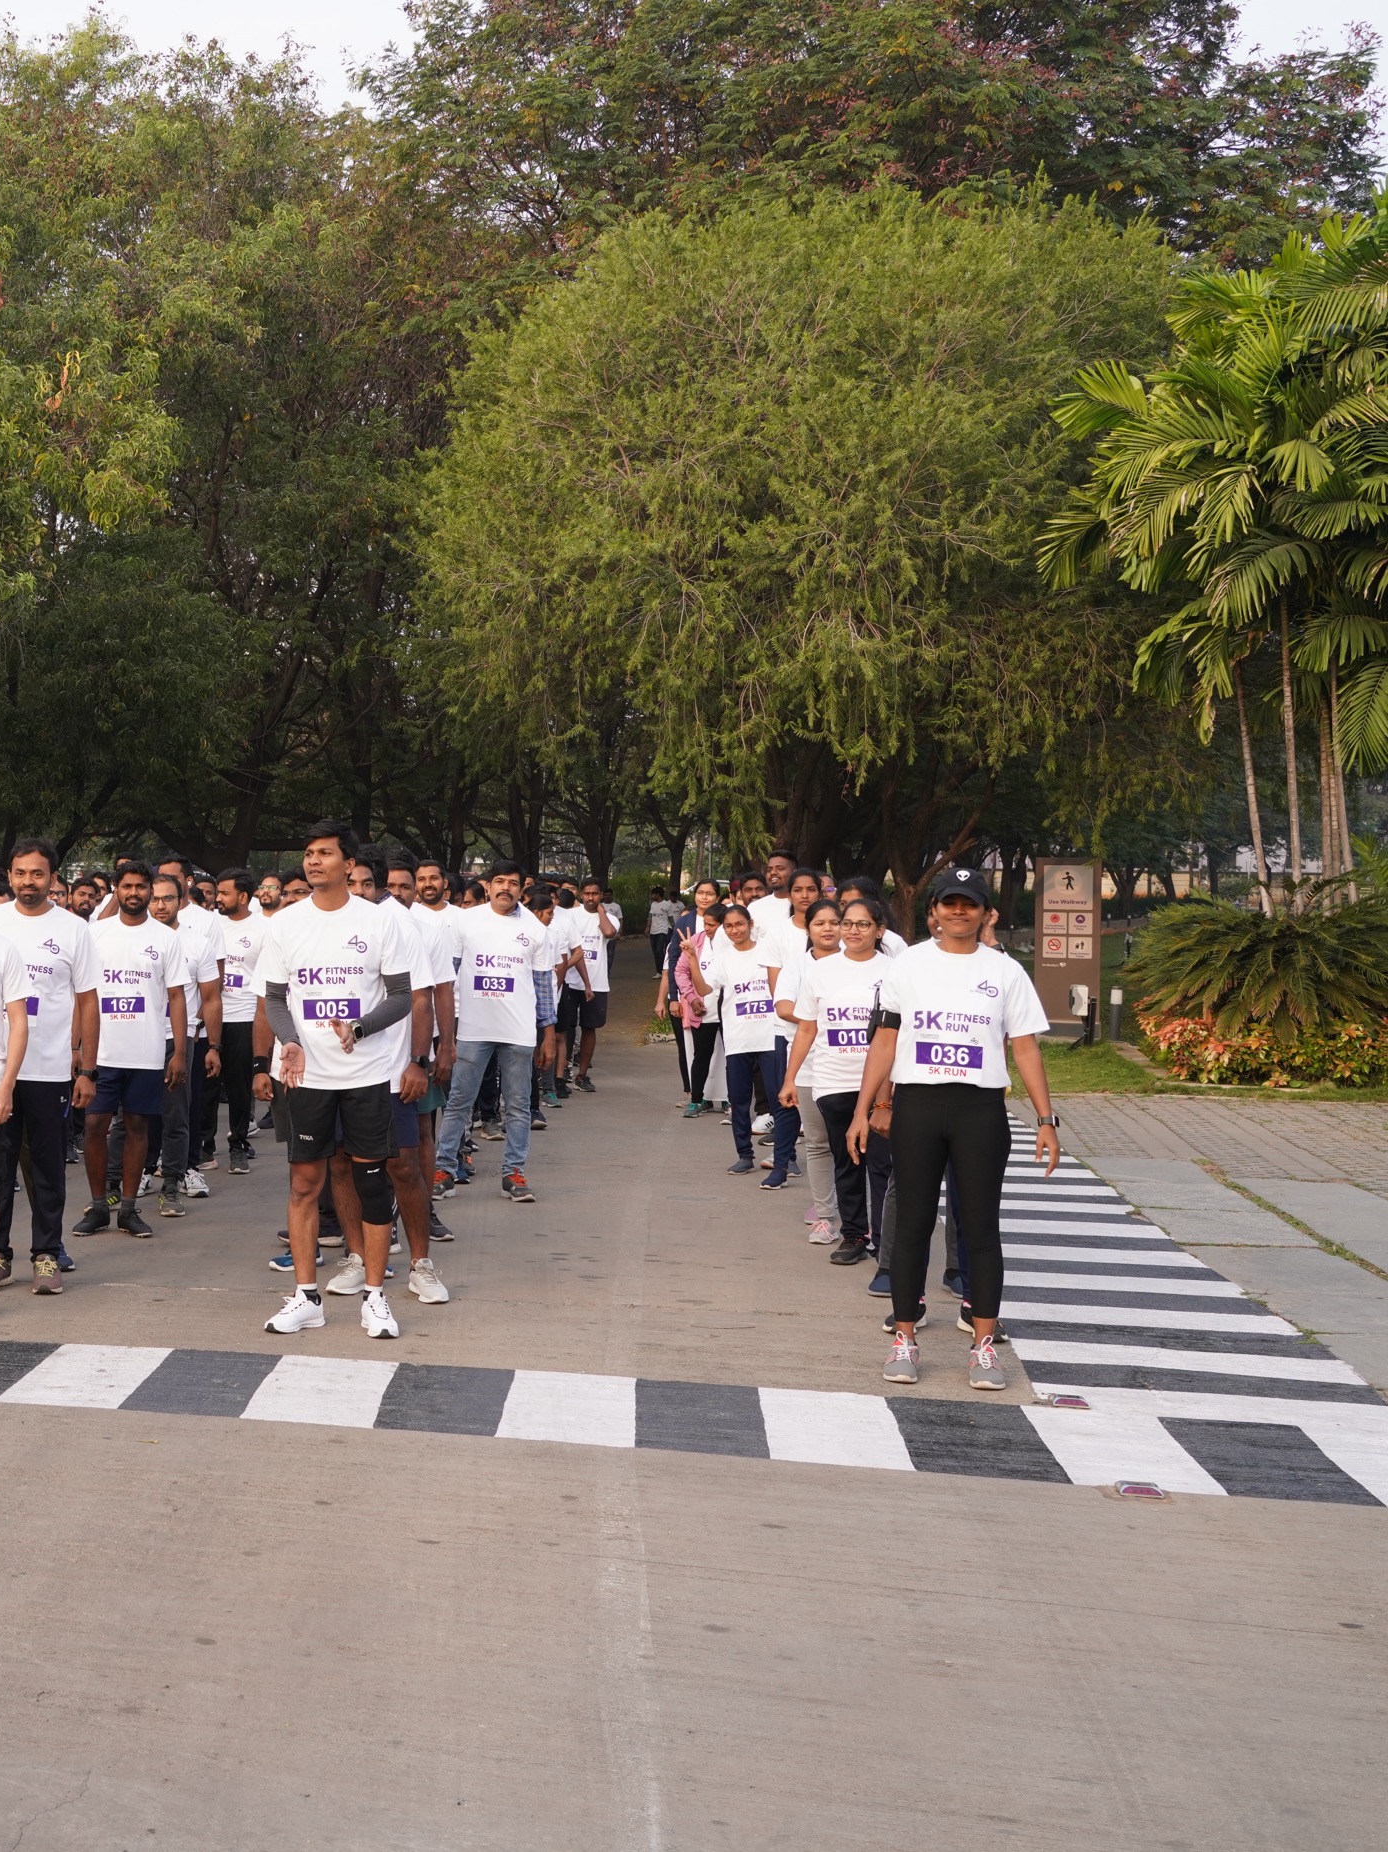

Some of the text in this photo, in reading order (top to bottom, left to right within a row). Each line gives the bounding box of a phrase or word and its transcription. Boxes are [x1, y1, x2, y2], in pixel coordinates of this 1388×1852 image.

[226, 954, 245, 963] TNESS
[583, 950, 593, 958] 20
[475, 954, 524, 968] 5K FITNESS
[25, 964, 54, 975] TNESS
[297, 966, 364, 985] 5K FITNESS
[103, 969, 152, 984] 5K FITNESS
[325, 976, 346, 985] RUN
[482, 978, 506, 991] 033
[734, 982, 751, 994] 5K
[110, 998, 136, 1012] 167
[315, 1000, 349, 1018] 005
[744, 1002, 767, 1013] 175
[827, 1007, 851, 1022] 5K
[913, 1010, 991, 1030] 5K FITNESS
[945, 1022, 969, 1033] RUN
[838, 1030, 867, 1045] 010
[930, 1044, 970, 1065] 036
[928, 1066, 967, 1077] 5K RUN
